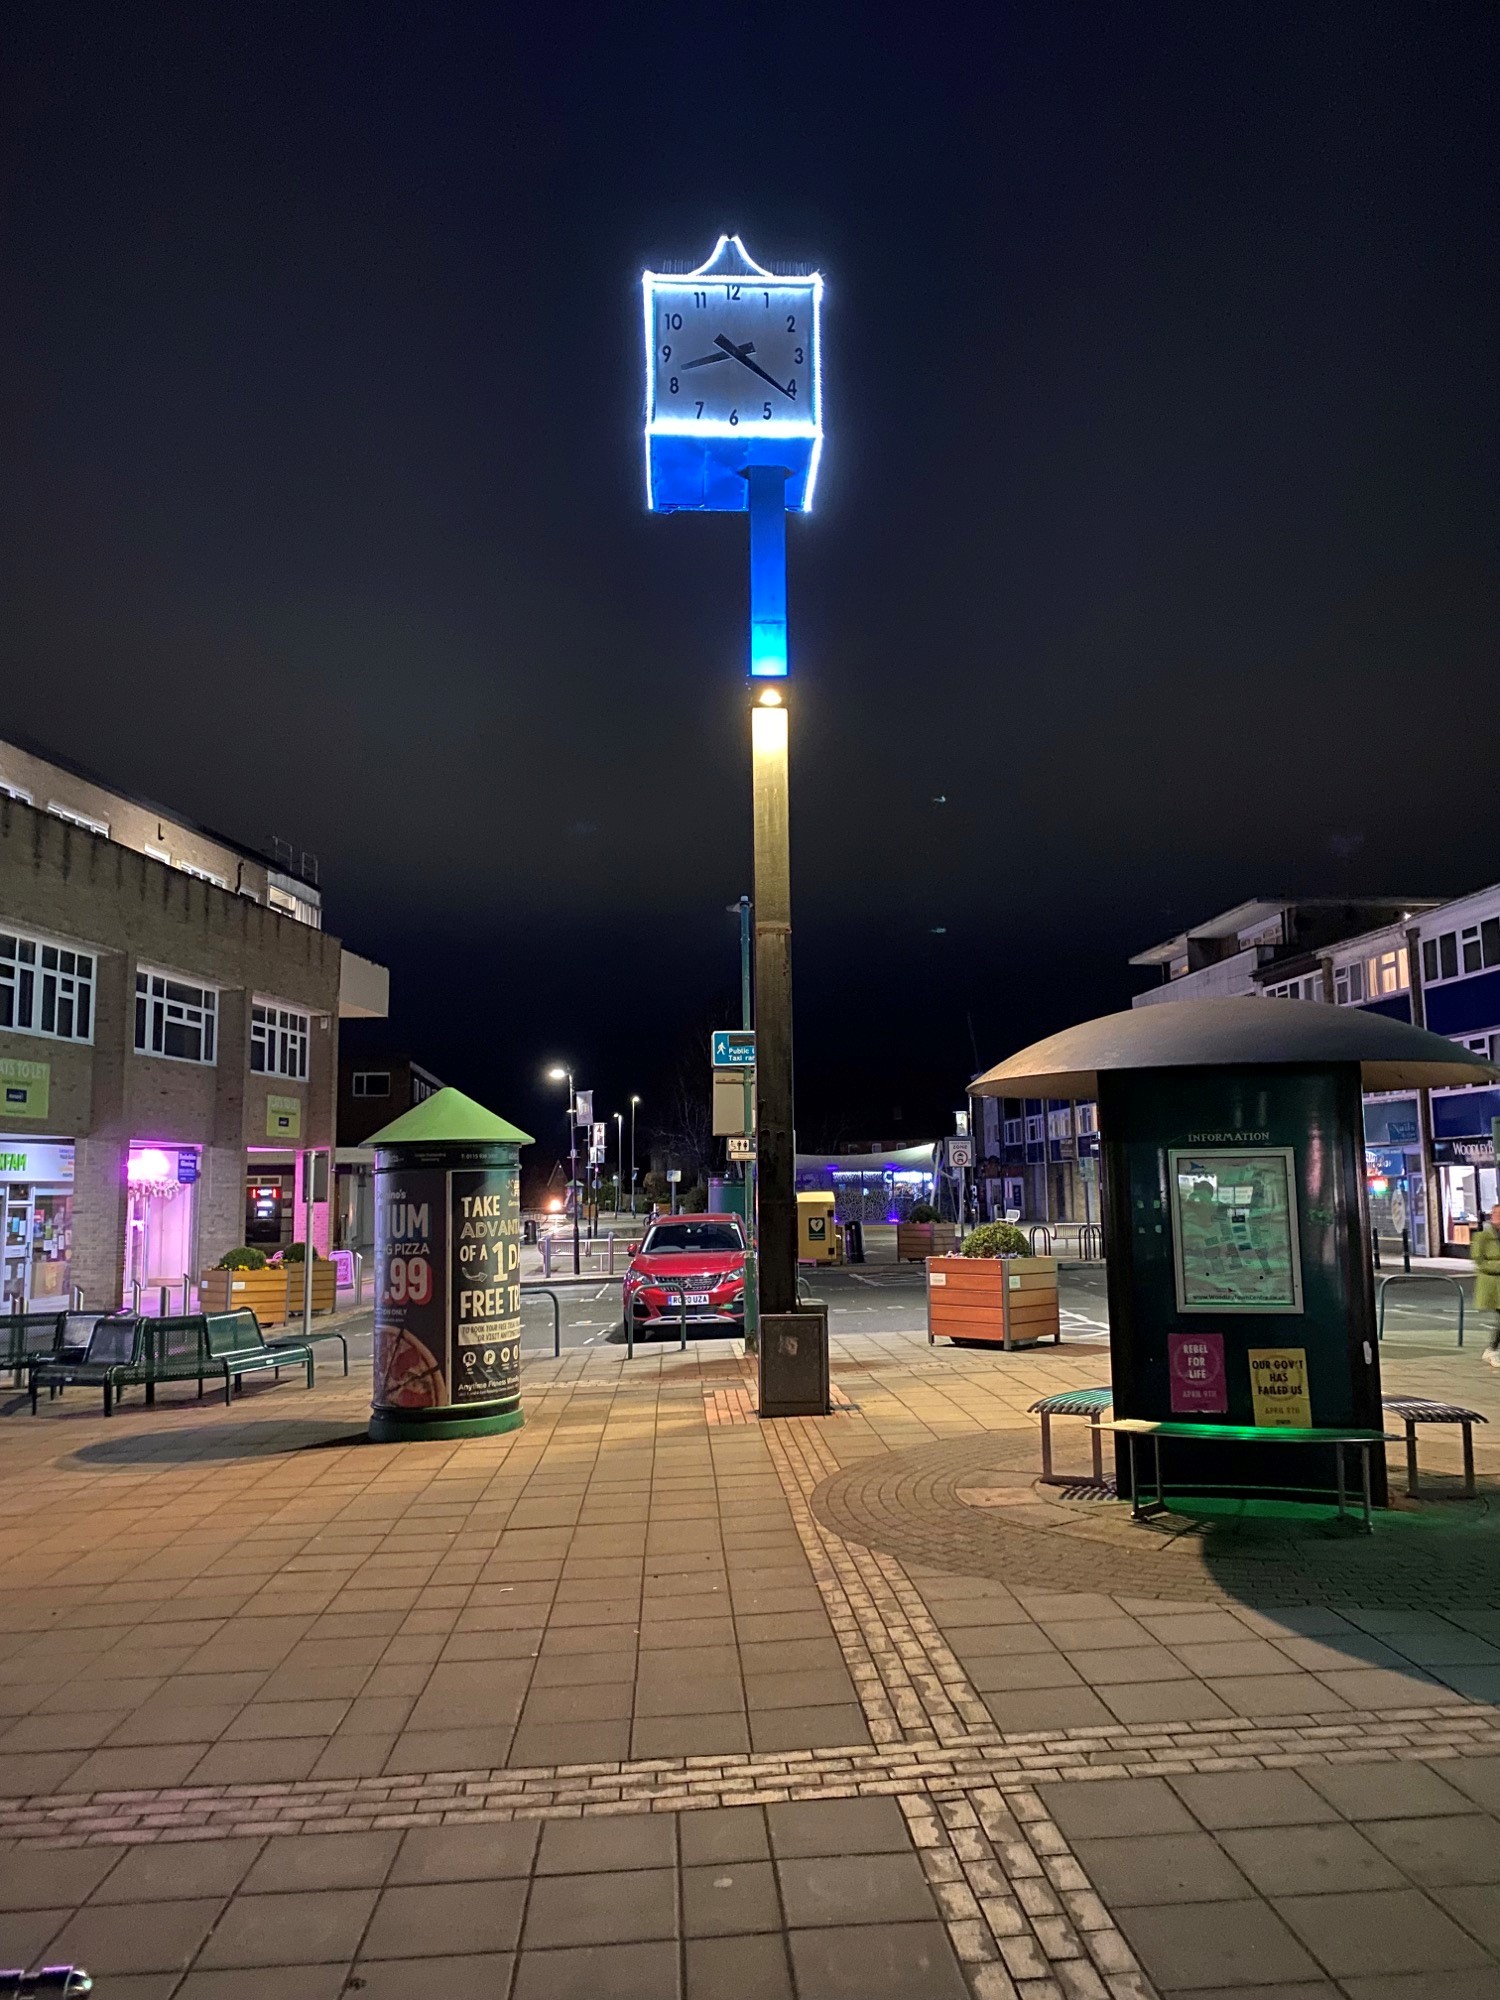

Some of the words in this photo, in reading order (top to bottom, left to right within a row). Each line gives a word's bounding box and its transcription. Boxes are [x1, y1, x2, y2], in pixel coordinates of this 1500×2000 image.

[693, 292, 707, 309] 11
[726, 284, 741, 301] 12
[763, 292, 770, 309] 1
[664, 313, 683, 331] 10
[786, 315, 796, 333] 2
[662, 345, 672, 363] 9
[794, 347, 804, 365] 3
[669, 376, 680, 394] 8
[786, 378, 798, 397] 4
[695, 401, 705, 420] 7
[729, 408, 739, 427] 6
[762, 401, 772, 421] 5
[1187, 1131, 1270, 1143] INFORMATION
[460, 1195, 500, 1218] TAKE
[394, 1243, 430, 1256] PIZZA
[460, 1245, 477, 1262] OF
[479, 1244, 488, 1261] A
[491, 1240, 509, 1283] 1
[460, 1287, 504, 1319] FREE
[692, 1295, 708, 1303] UZA
[1183, 1344, 1208, 1354] REBEL
[1187, 1357, 1206, 1366] FOR
[1252, 1360, 1271, 1370] OUR
[1273, 1360, 1304, 1370] GOV'T
[1188, 1369, 1207, 1379] LIFE
[1269, 1373, 1289, 1383] HAS
[1257, 1385, 1289, 1396] FAILED
[1290, 1385, 1303, 1395] US
